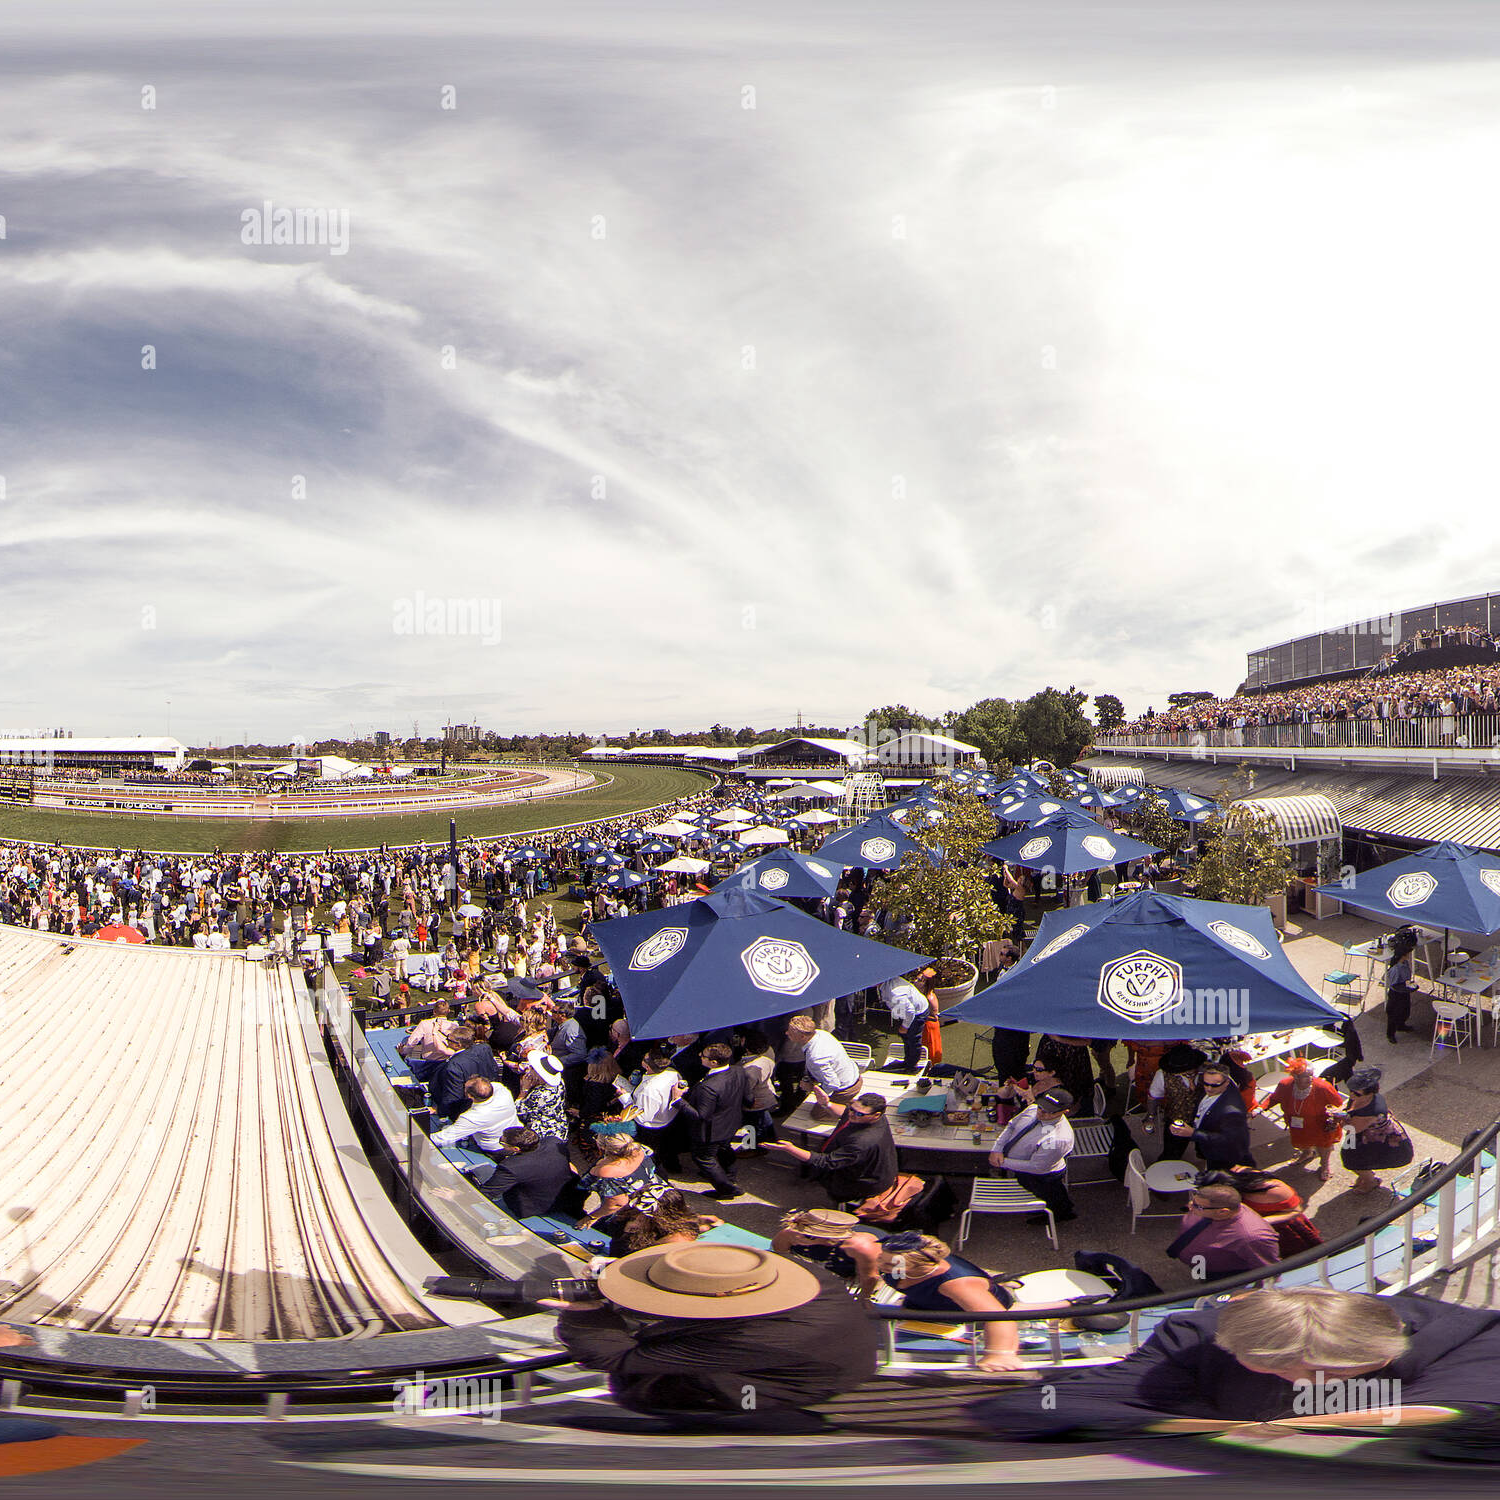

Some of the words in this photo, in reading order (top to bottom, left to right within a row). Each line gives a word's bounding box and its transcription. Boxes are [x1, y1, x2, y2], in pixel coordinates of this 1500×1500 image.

[1403, 878, 1429, 889] FURPHY
[755, 947, 795, 964] FURPHY
[1116, 963, 1169, 980] FURPHY
[1116, 990, 1154, 1007] REFRESHING
